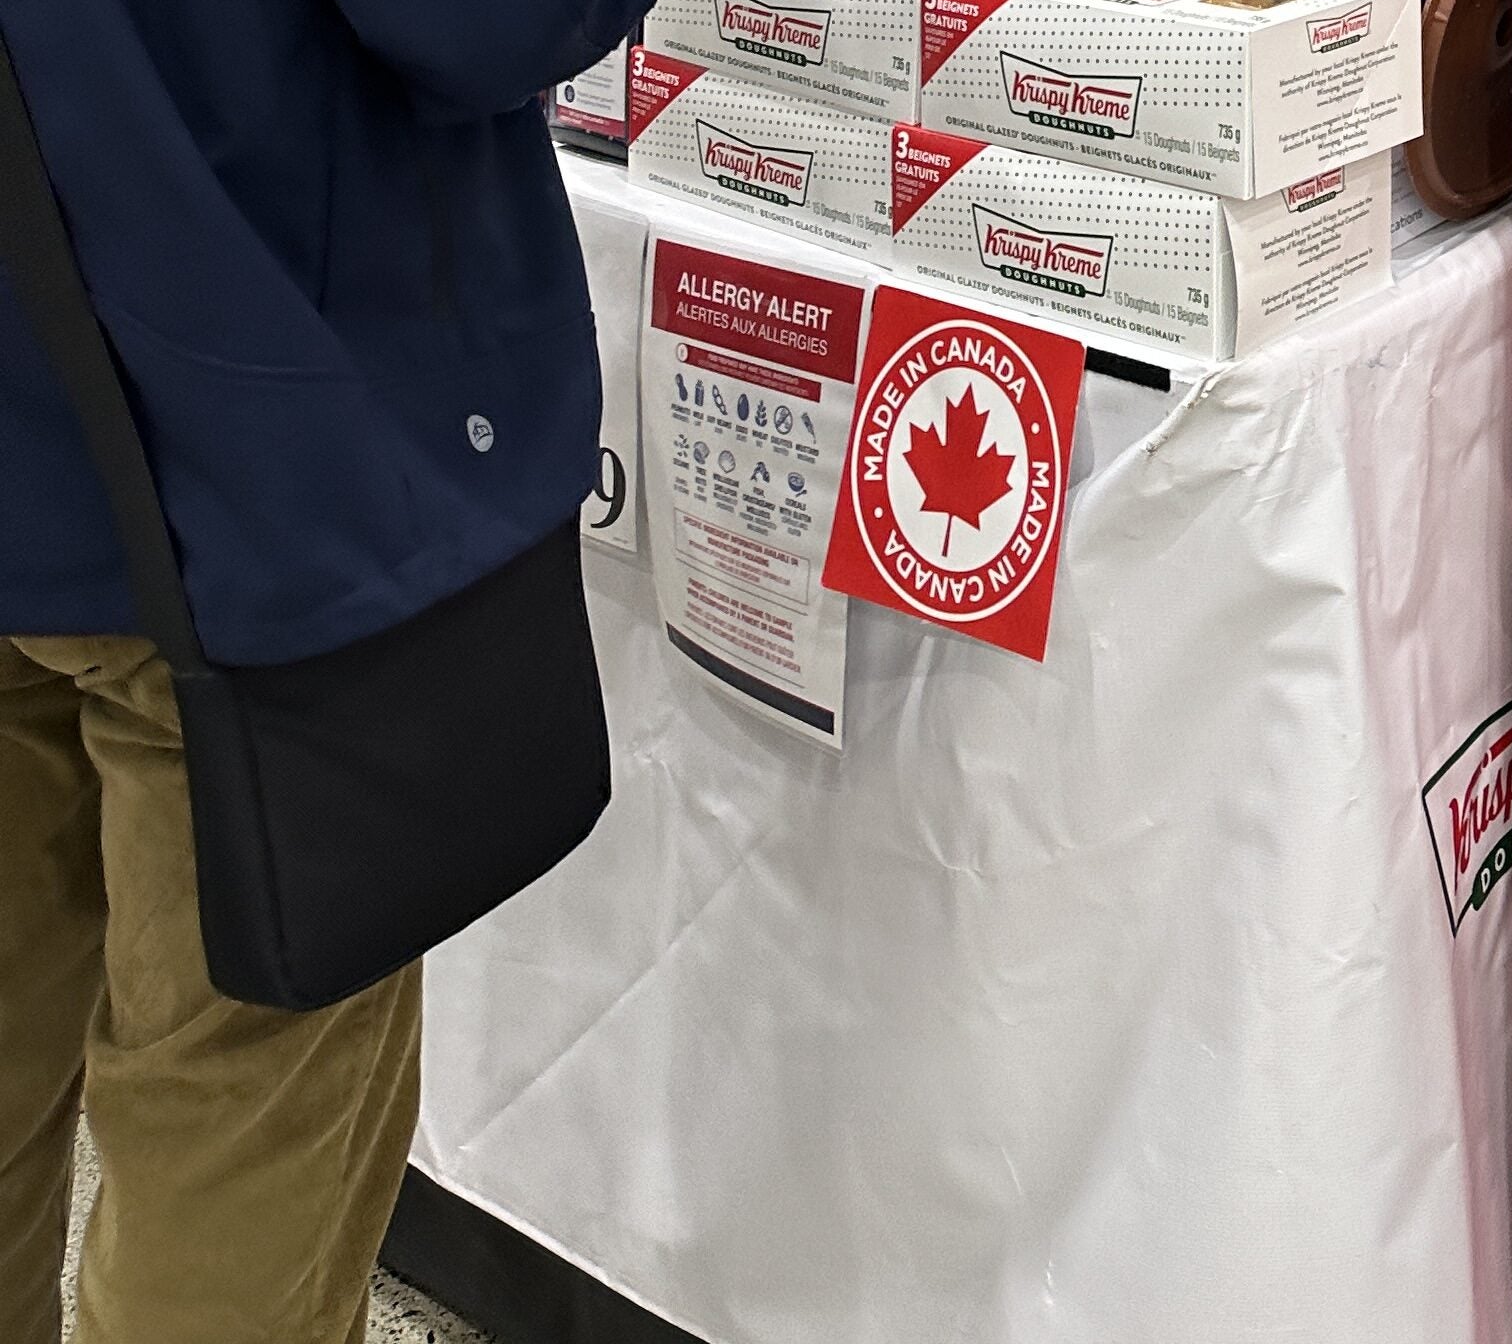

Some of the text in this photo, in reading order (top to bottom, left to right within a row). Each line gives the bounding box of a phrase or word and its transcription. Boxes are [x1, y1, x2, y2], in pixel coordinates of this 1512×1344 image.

[722, 1, 823, 49] Krispy Kreme
[924, 12, 968, 32] GRATUITS
[633, 51, 645, 76] 3
[1011, 71, 1132, 121] Krispy Kreme
[945, 115, 985, 132] ORIGINAL
[1020, 132, 1075, 151] DOUGHNUTS
[1081, 145, 1122, 162] BEIGNETS
[1033, 112, 1110, 138] DOUGHNUTS
[1218, 123, 1234, 140] 735
[705, 138, 805, 190] Krispy Kreme
[895, 131, 951, 168] 3 BEIGNETS
[895, 161, 939, 183] GRATUITS
[984, 224, 1104, 279] Krispy Kreme
[677, 272, 832, 332] ALLERGY ALERT
[1003, 266, 1082, 296] DOUGHNUTS
[676, 301, 828, 357] ALERTES AUX ALLERGIES
[864, 382, 902, 480] MADE
[900, 353, 927, 389] IN
[930, 338, 1027, 404] CANADA
[1015, 461, 1050, 564] MADE
[883, 528, 985, 604] CANADA
[991, 556, 1017, 593] IN
